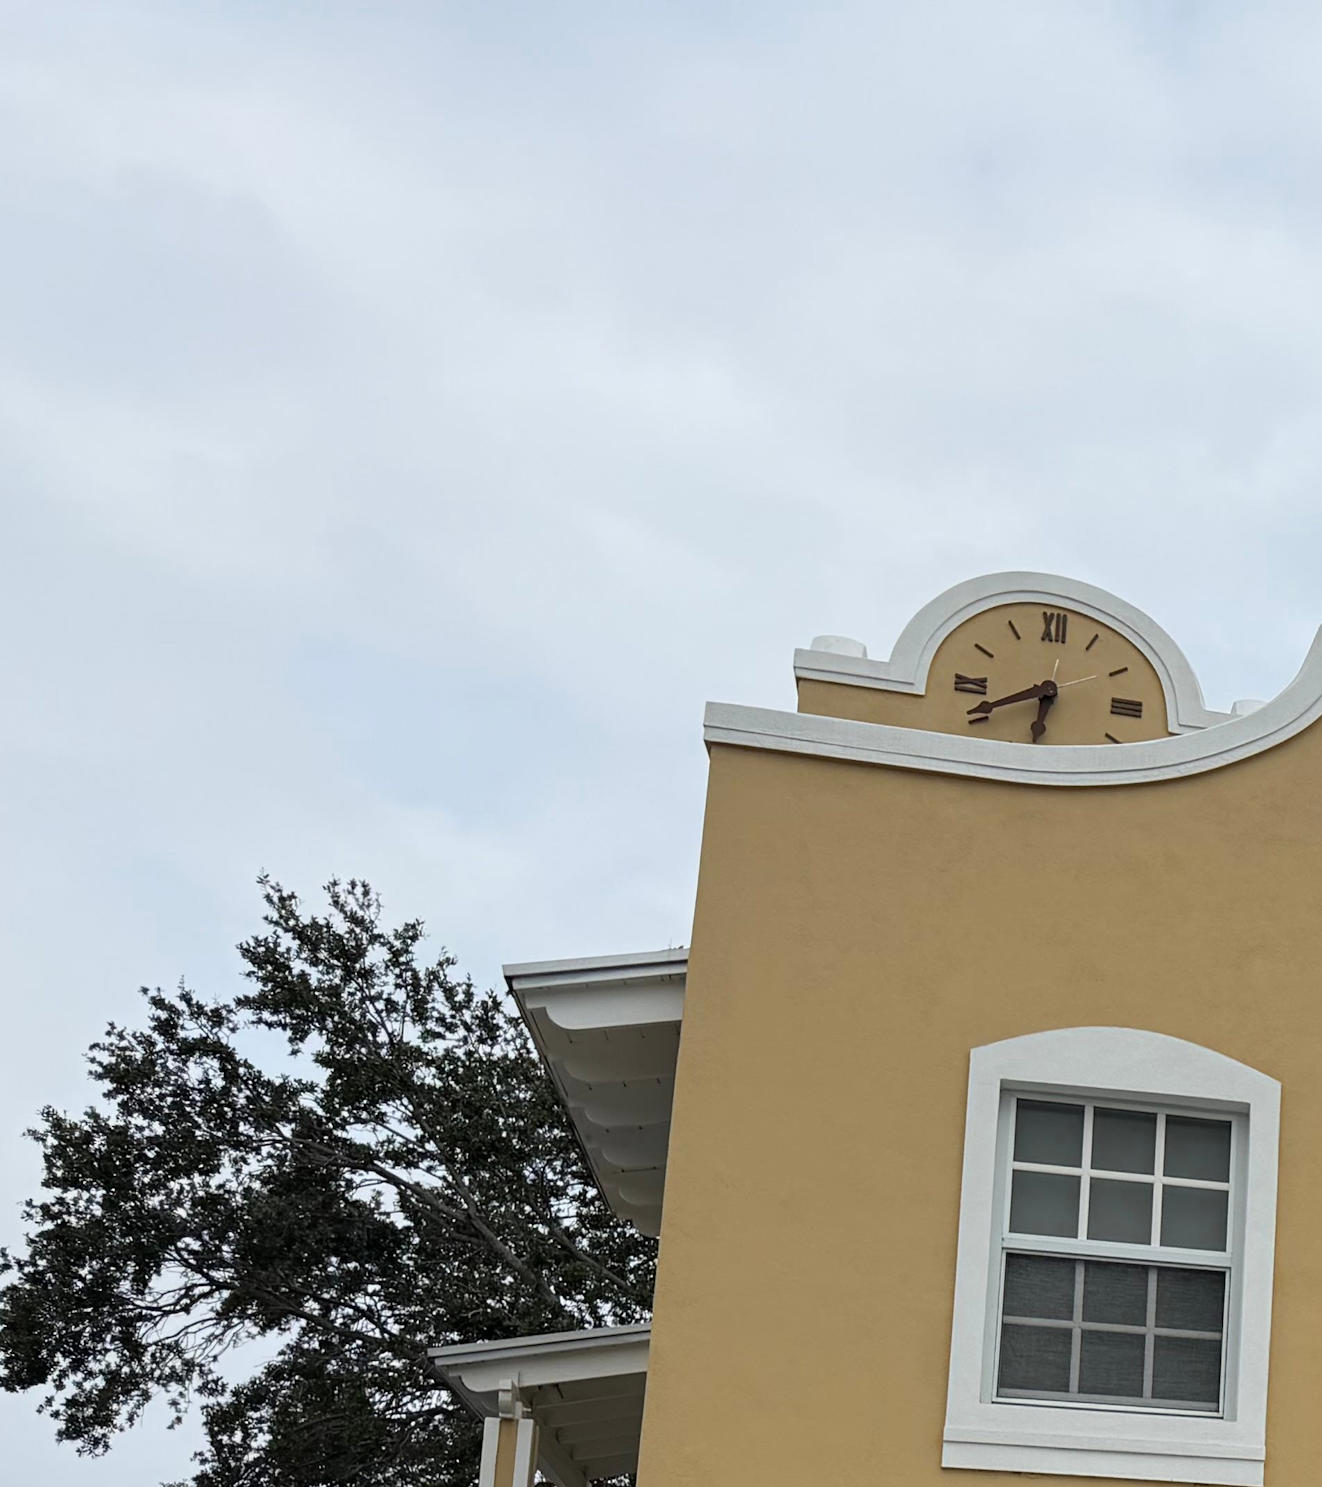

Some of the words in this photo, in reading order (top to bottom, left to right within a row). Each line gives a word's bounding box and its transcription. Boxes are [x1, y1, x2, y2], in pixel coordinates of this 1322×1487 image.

[1041, 611, 1068, 644] XII
[954, 673, 988, 695] IX
[1110, 697, 1143, 718] III
